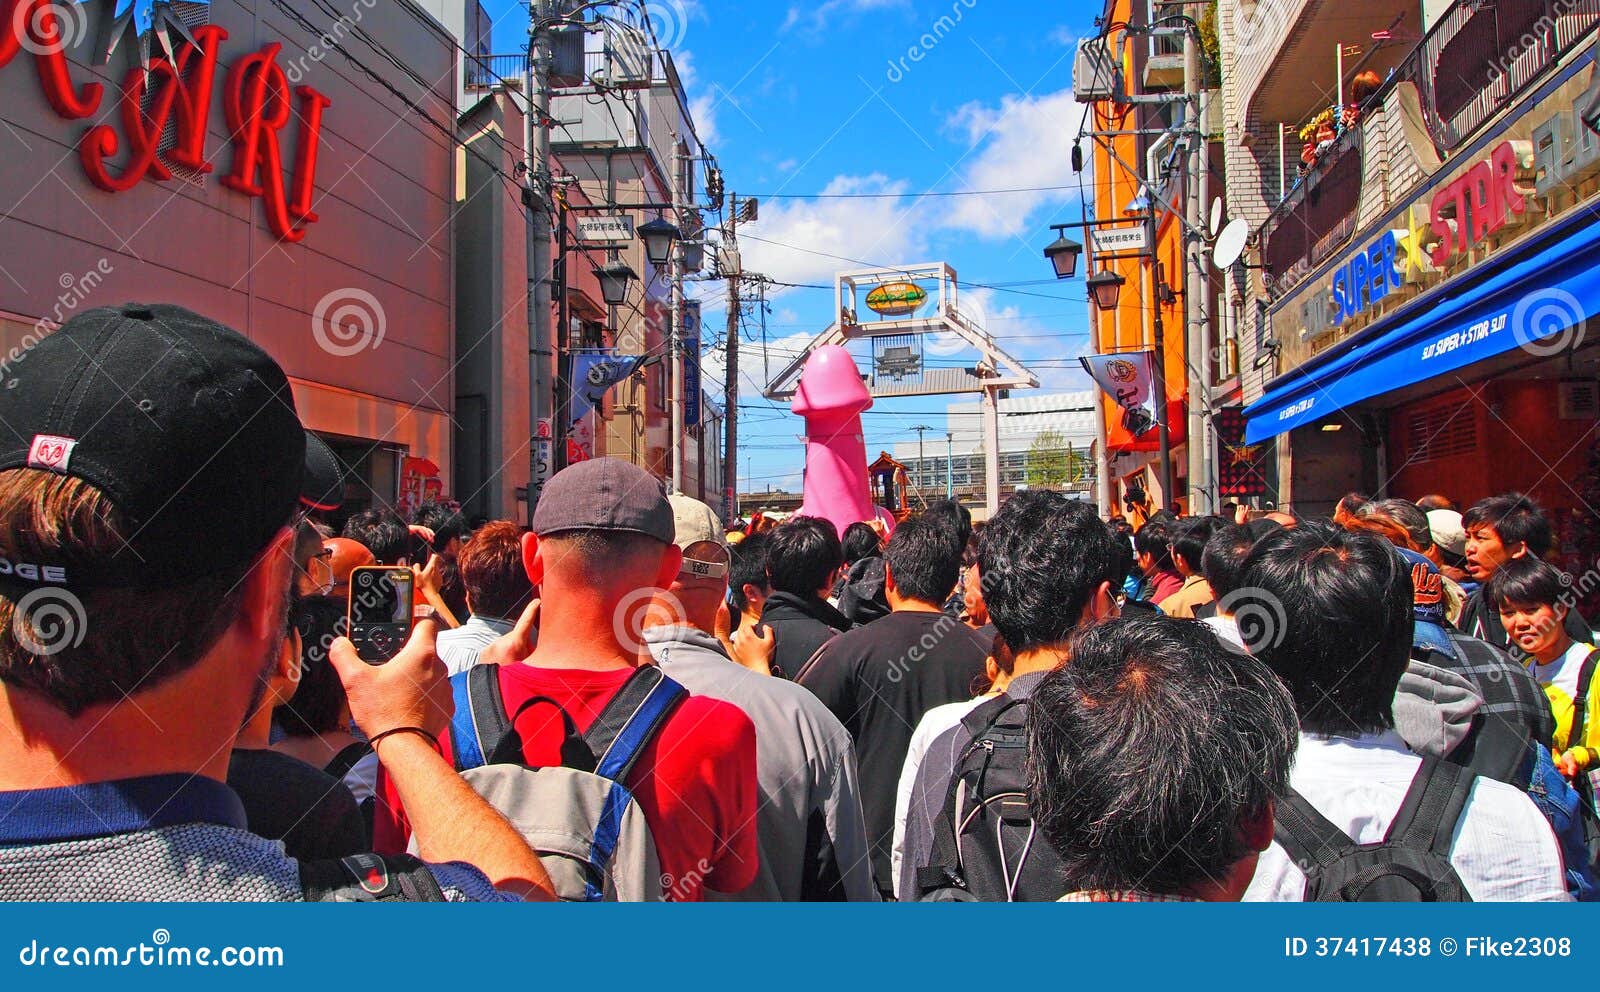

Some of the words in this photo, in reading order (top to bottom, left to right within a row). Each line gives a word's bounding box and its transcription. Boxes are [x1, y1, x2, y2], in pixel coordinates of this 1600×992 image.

[1332, 229, 1401, 326] SUPER
[1431, 139, 1525, 268] STAR
[1434, 332, 1460, 357] SUPER
[1466, 320, 1489, 345] STAR
